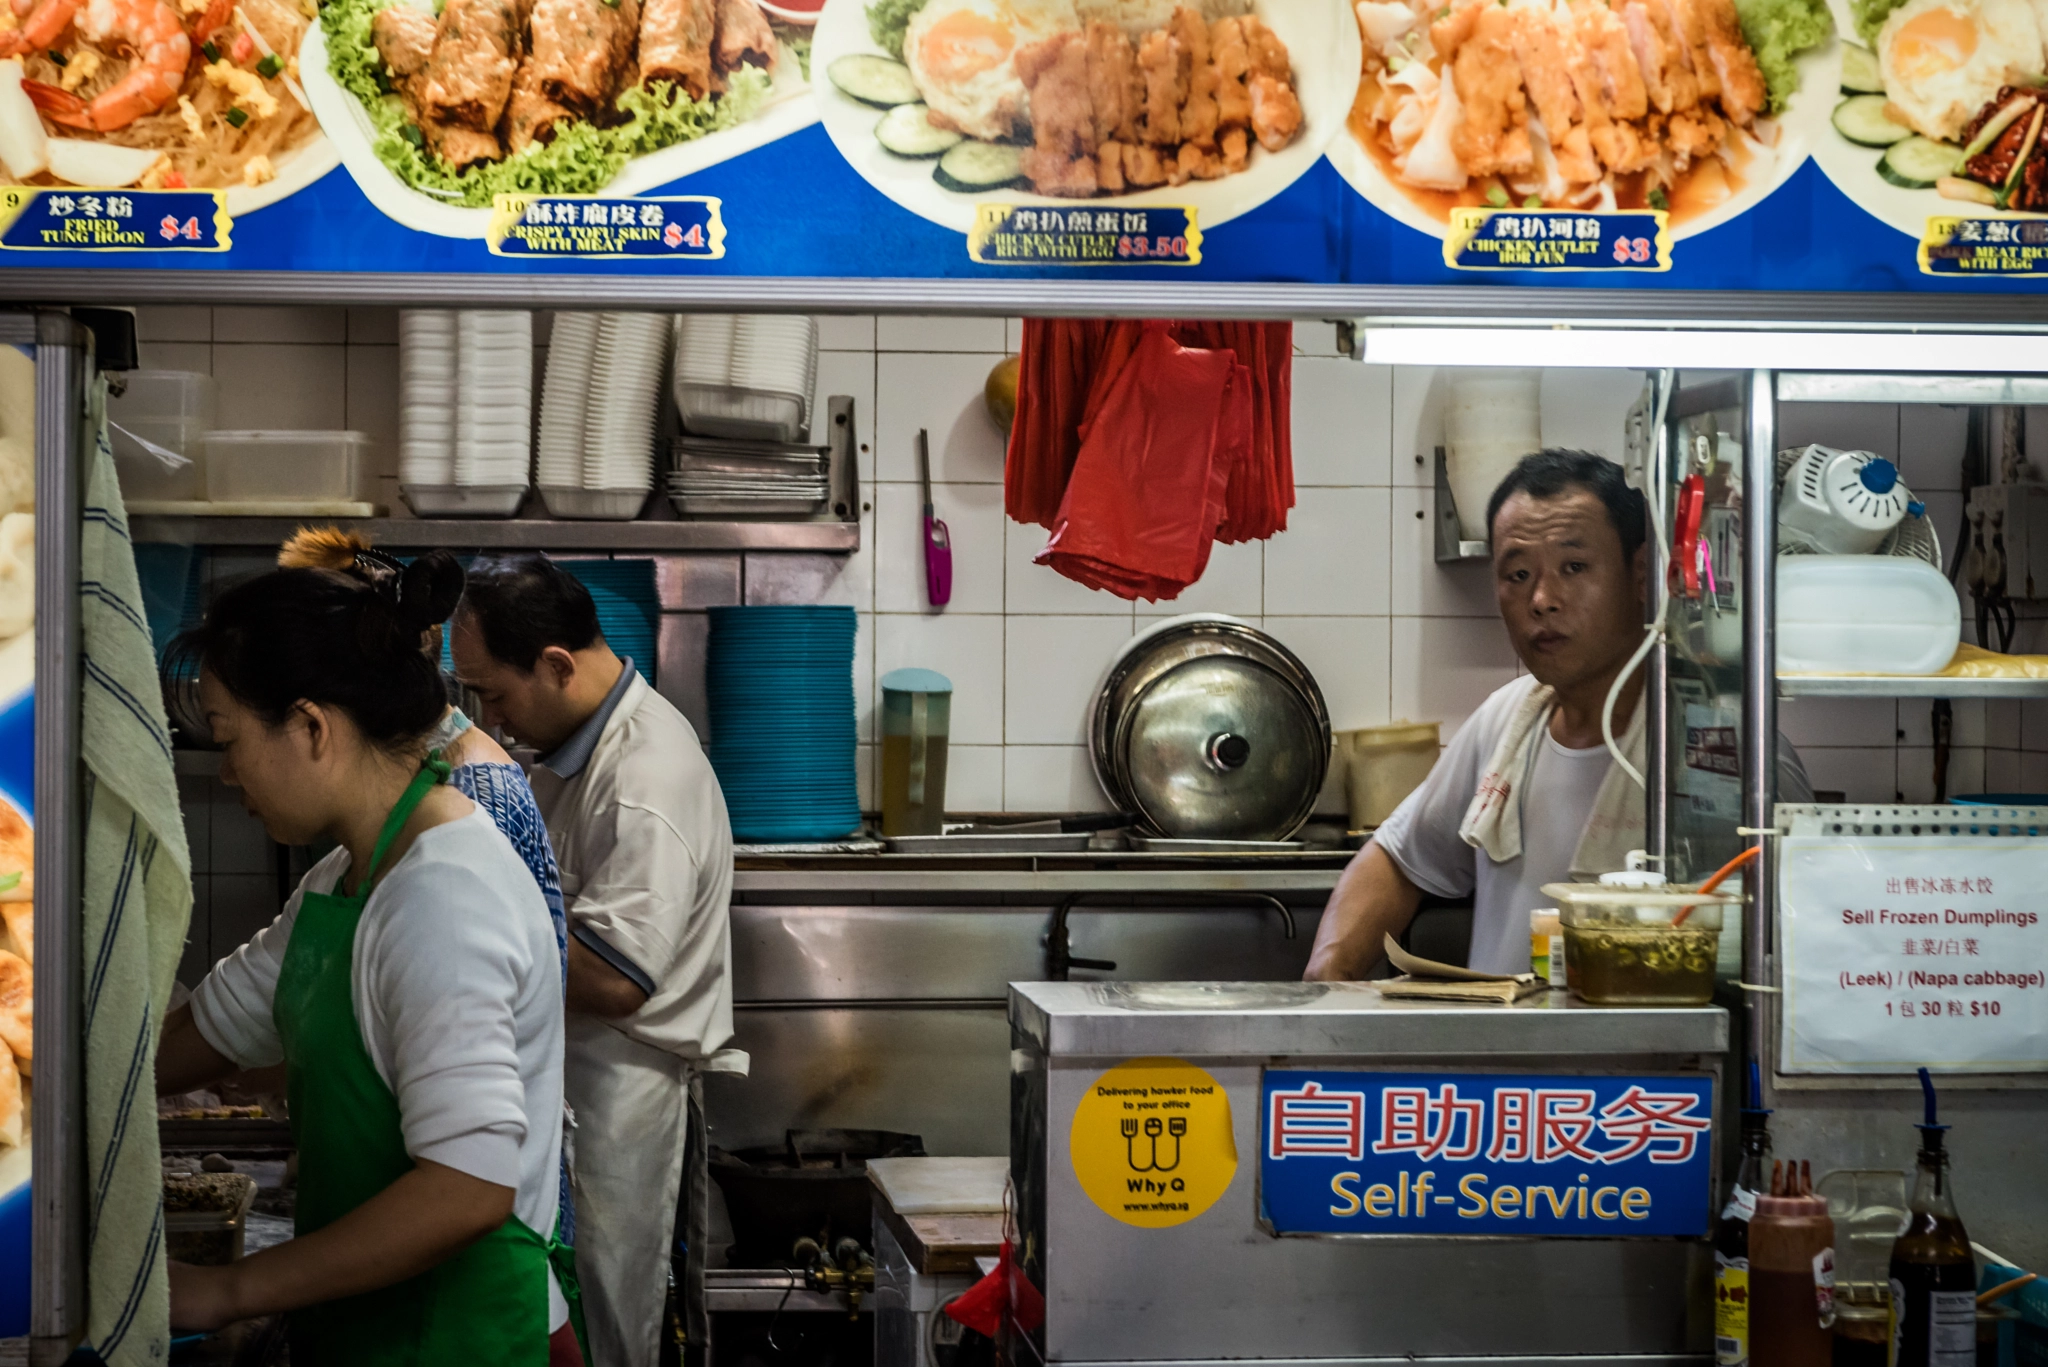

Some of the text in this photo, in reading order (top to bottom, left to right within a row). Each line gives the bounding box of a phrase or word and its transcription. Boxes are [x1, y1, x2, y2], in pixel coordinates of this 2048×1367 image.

[7, 193, 19, 208] 9
[49, 195, 133, 218] 炒冬粉
[505, 200, 525, 213] 10
[64, 219, 119, 232] FRIED
[160, 215, 202, 241] $4
[1014, 210, 1147, 232] 鸡扒煎蛋饭
[1463, 217, 1482, 230] 12
[1494, 216, 1600, 239] 鸡扒河粉
[40, 230, 145, 244] TUNG HOON
[503, 225, 660, 241] CRISPY TOFU SKIN
[663, 222, 705, 248] $4
[984, 233, 1118, 247] CHICKEN CUTLET
[526, 237, 627, 252] WITH MEAT
[996, 244, 1114, 257] RICE WITH EGG
[1117, 234, 1188, 258] $3.50
[1467, 239, 1600, 254] CHICKEN CUTLET
[1612, 235, 1650, 264] $3
[1975, 246, 2019, 259] MEAT
[2021, 246, 2048, 259] RIC
[1499, 251, 1565, 264] HOR FUN
[1959, 257, 2032, 270] WITH EGG
[1886, 877, 1994, 895] 出售冰冻水饺
[1842, 910, 2038, 927] Sell Frozen Dumplings
[1902, 937, 1980, 956] 韭菜/白菜
[1839, 970, 1893, 989] (Leek)
[1908, 970, 1959, 989] (Napa
[1963, 970, 2046, 989] cabbage)
[1885, 1000, 2001, 1018] 1 包 30 粒 $10
[1097, 1086, 1213, 1098] Delivering hawker food
[1123, 1100, 1191, 1112] to your office
[1269, 1081, 1711, 1165] 自助服务
[1330, 1170, 1652, 1220] Self-Service
